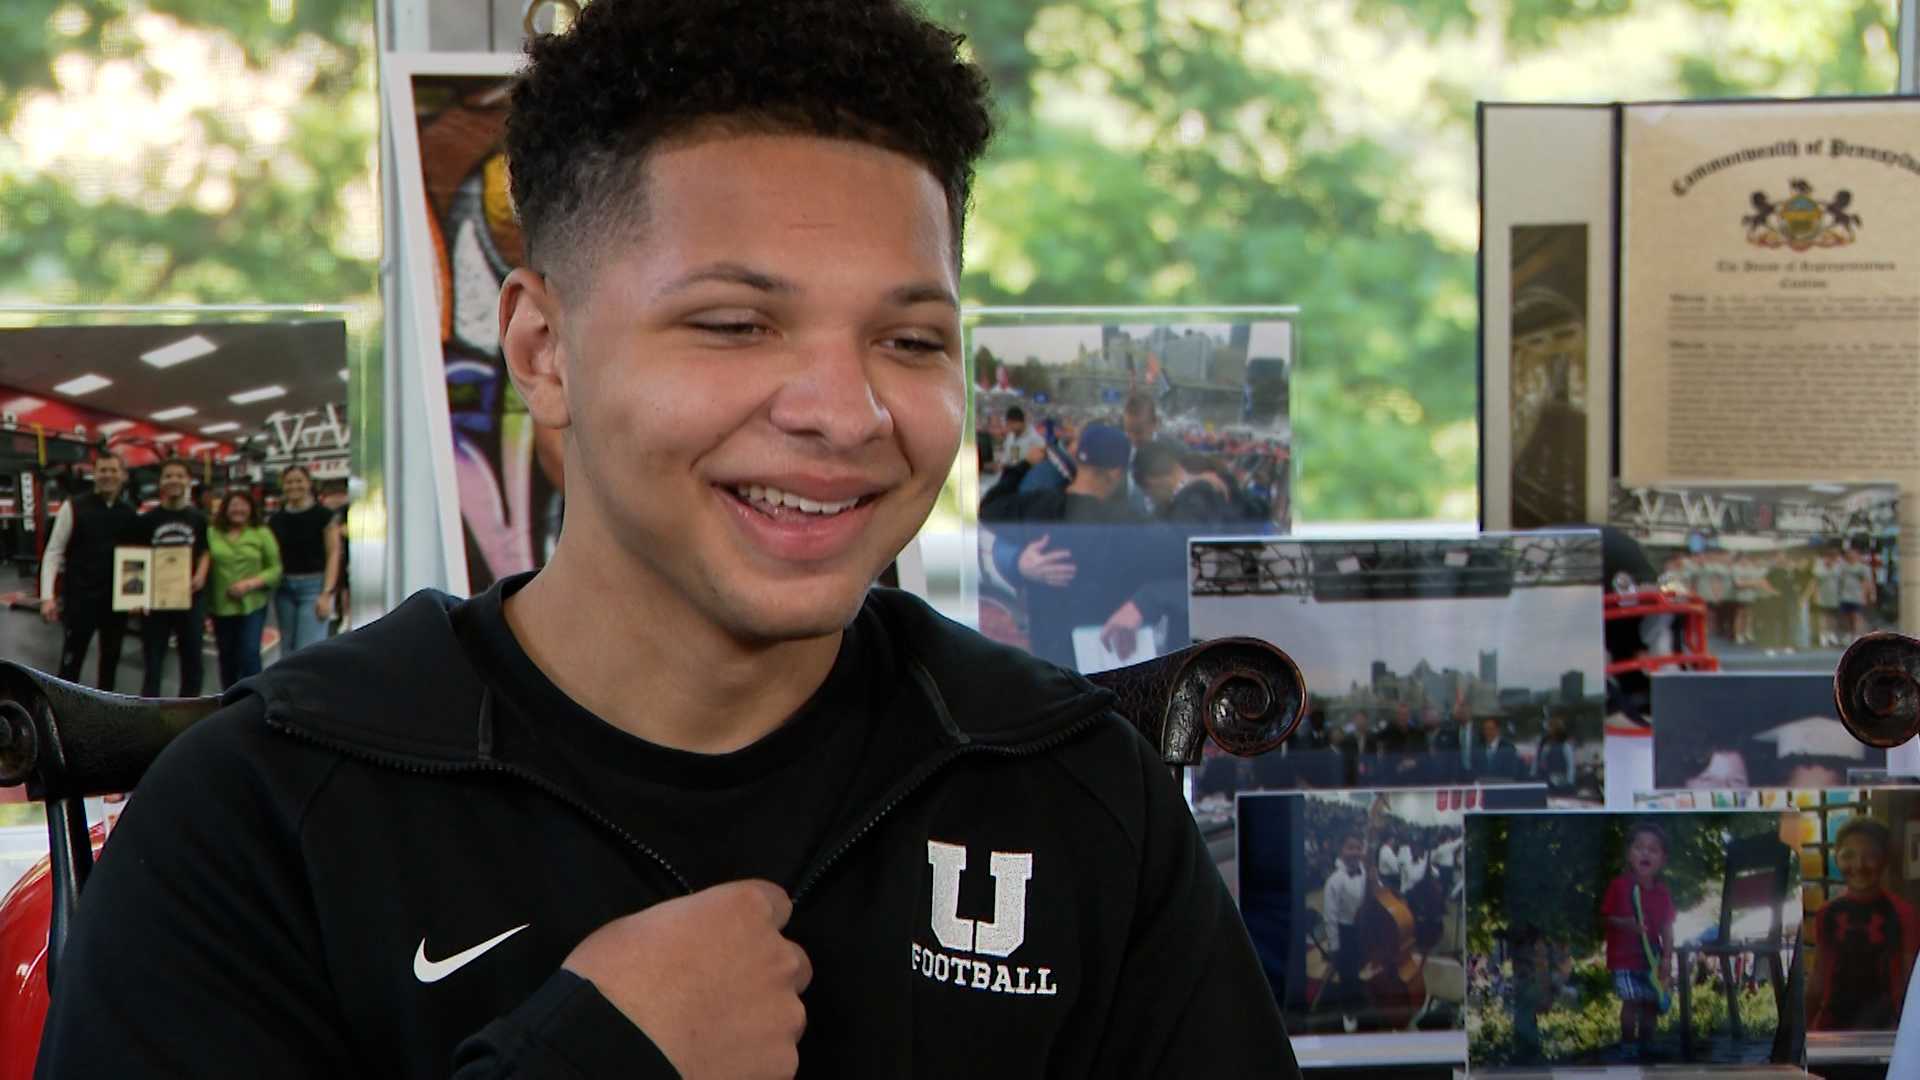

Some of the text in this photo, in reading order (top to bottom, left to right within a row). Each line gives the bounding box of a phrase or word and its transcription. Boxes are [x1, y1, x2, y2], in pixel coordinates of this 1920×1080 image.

[1672, 140, 1798, 196] Commonwealth
[1804, 138, 1823, 156] of
[927, 840, 1033, 957] U
[911, 942, 1057, 995] FOOTBALL
